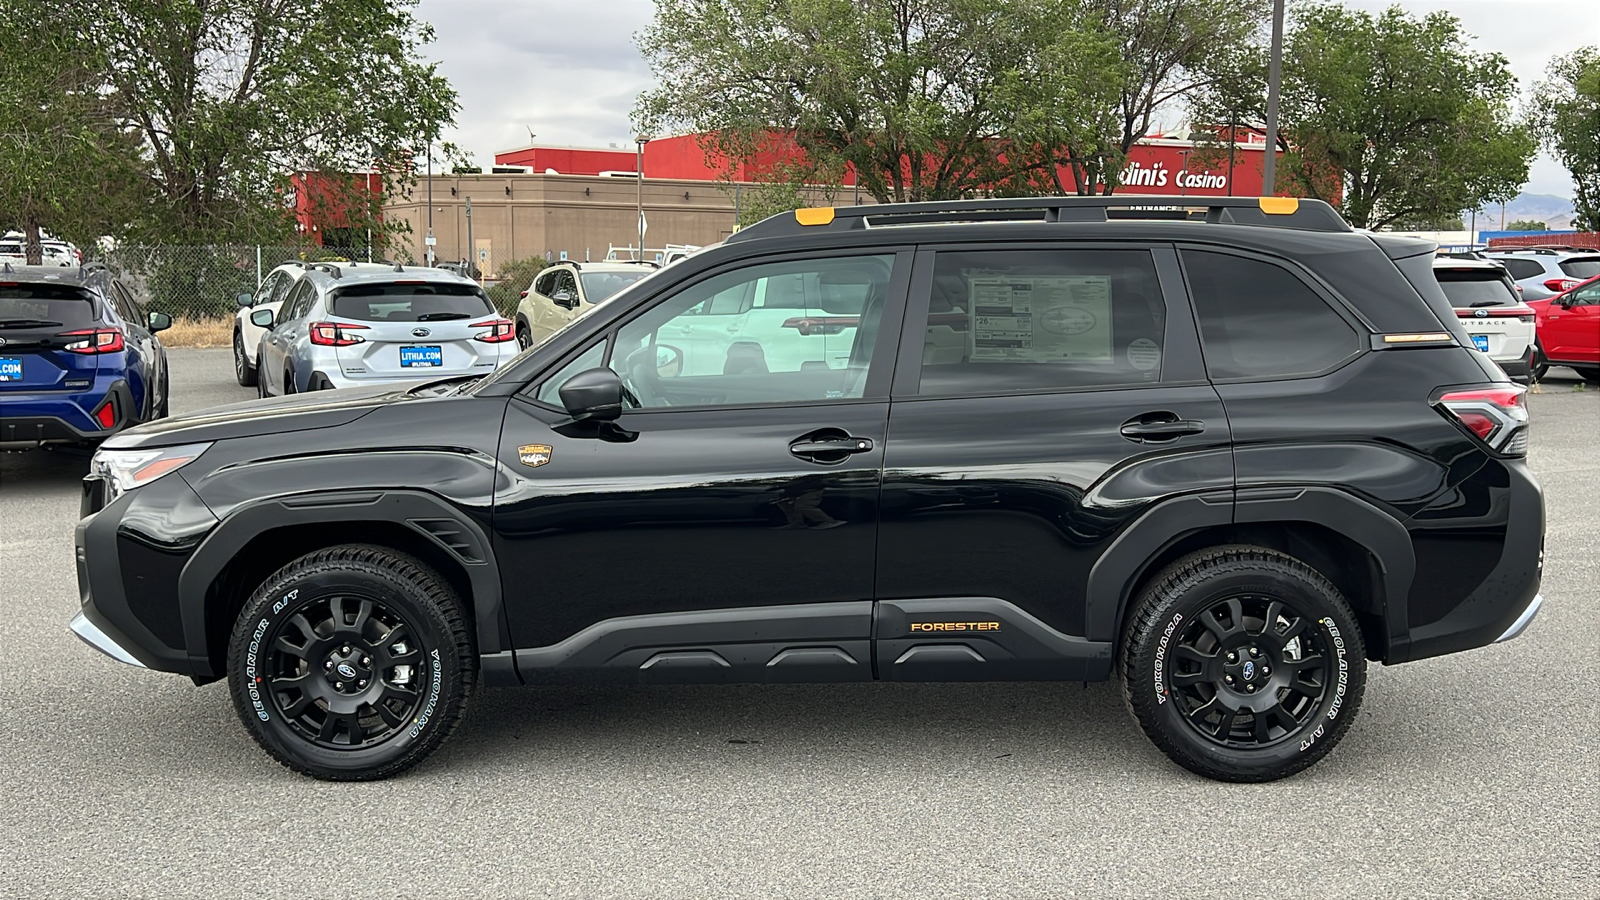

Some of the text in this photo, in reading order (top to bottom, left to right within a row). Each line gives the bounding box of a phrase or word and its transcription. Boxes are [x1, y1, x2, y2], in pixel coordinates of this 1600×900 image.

[1175, 170, 1227, 188] Casino
[401, 352, 441, 361] LITHIA.COM
[246, 589, 299, 721] GEOLANDAR A/T
[911, 622, 1000, 632] FORESTER
[1154, 613, 1183, 705] YOKOHAMA
[409, 648, 442, 738] YOKOHAMA
[1300, 616, 1348, 752] GEOLANDAR A/T
